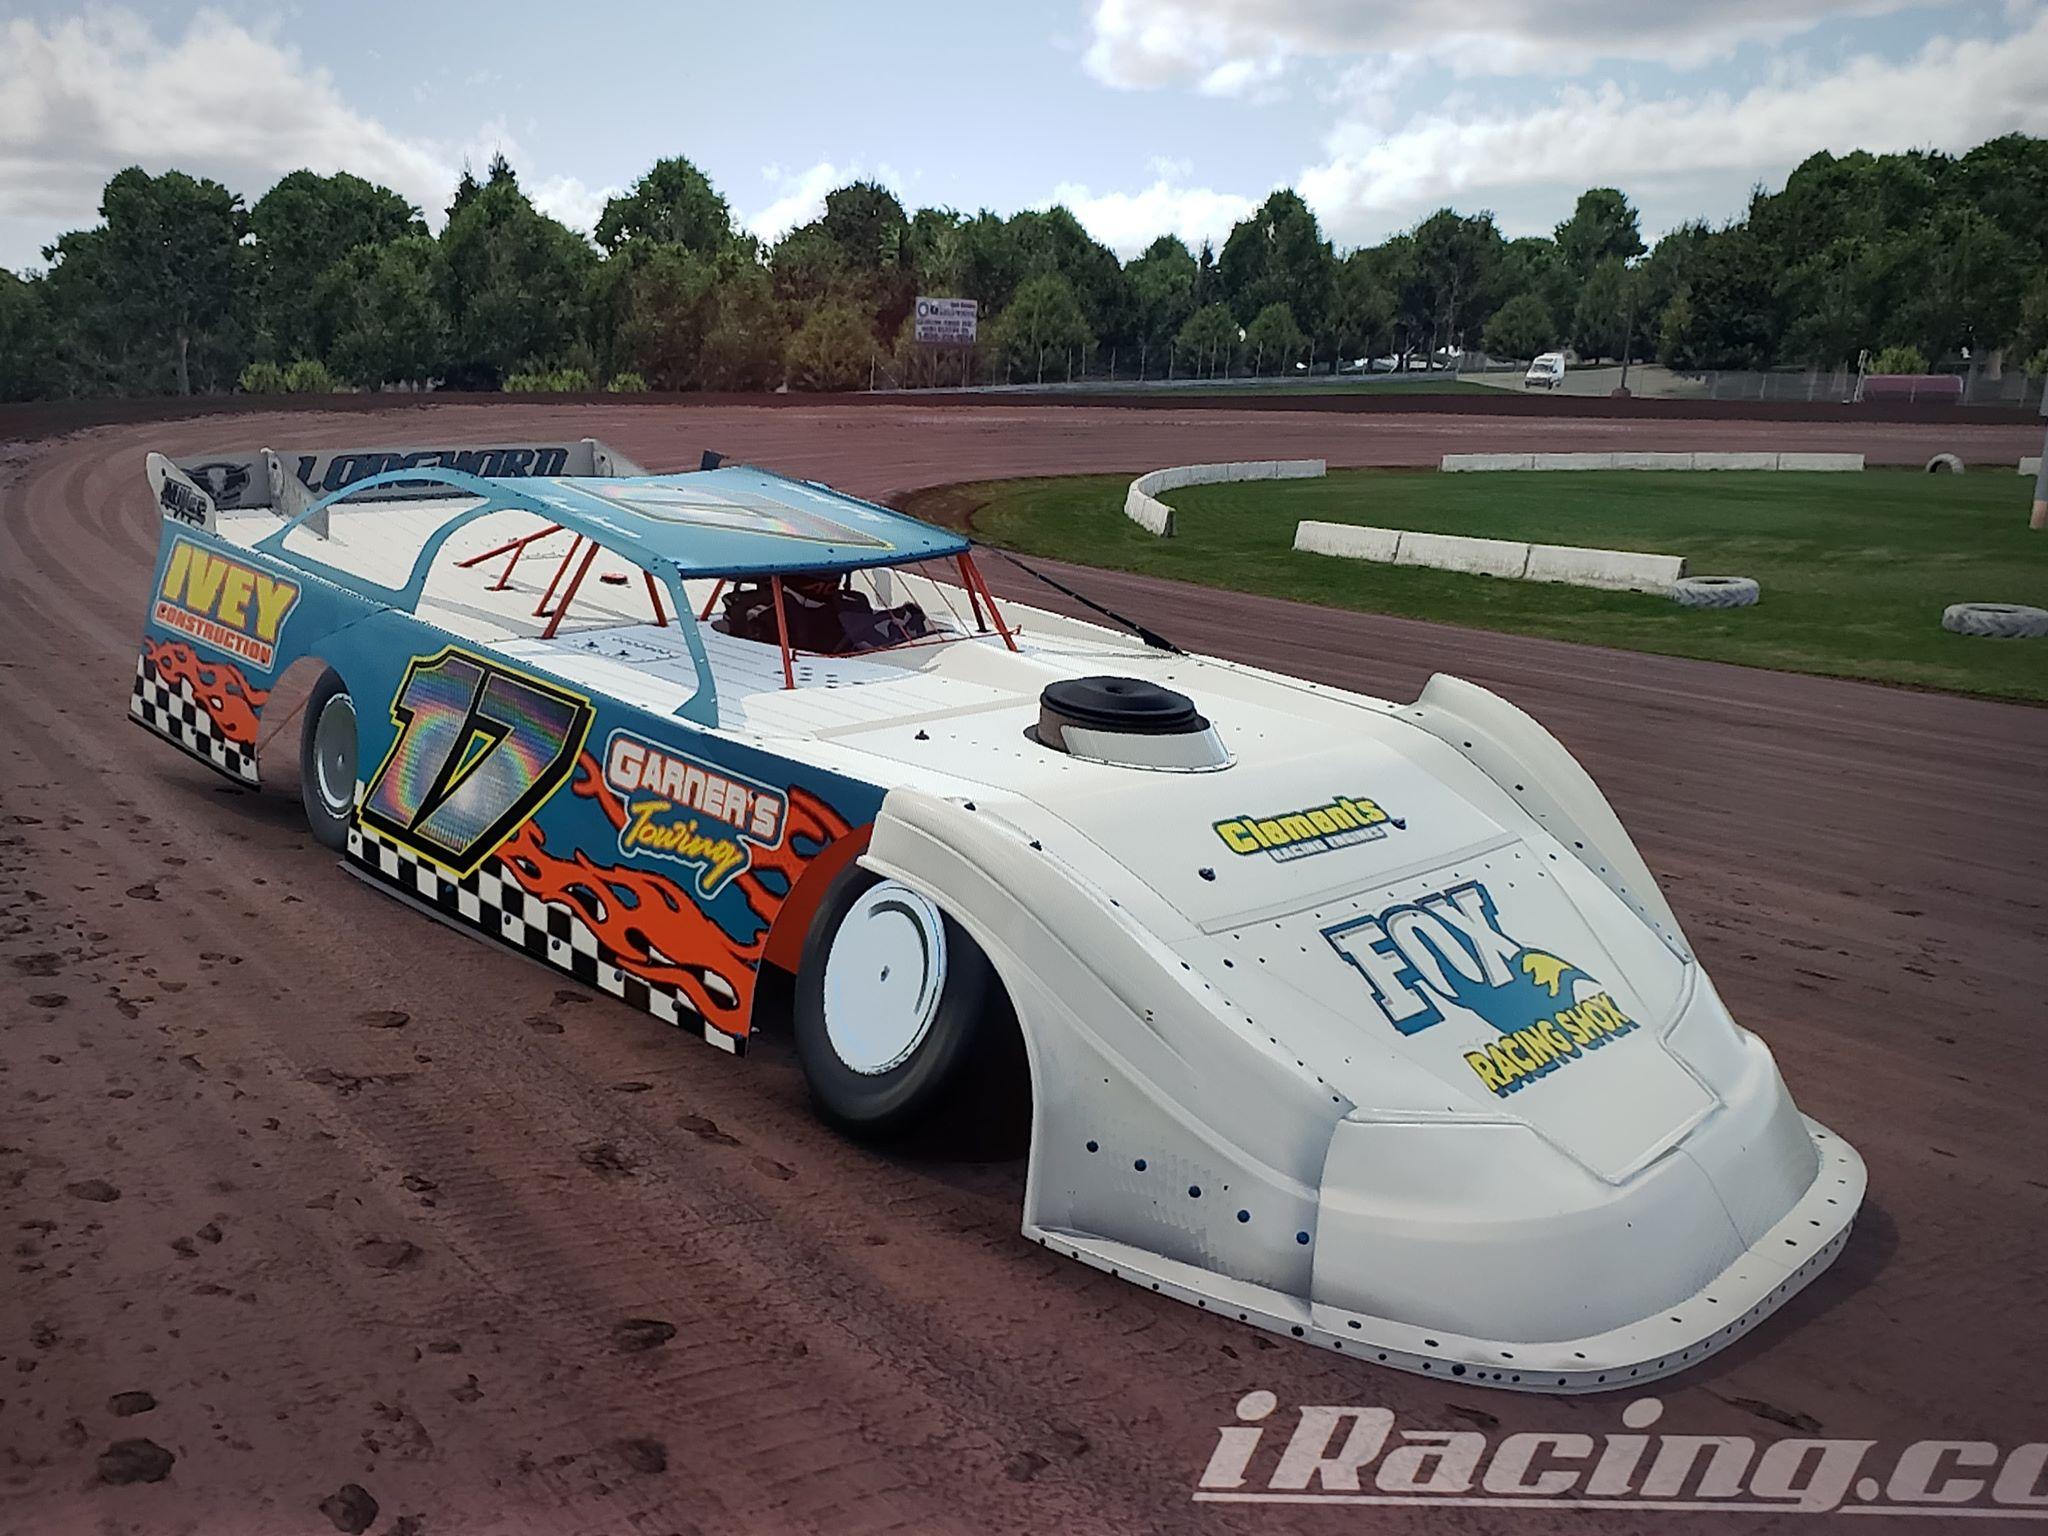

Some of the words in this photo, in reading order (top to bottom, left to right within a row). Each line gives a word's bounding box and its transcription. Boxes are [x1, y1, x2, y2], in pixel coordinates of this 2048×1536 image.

[155, 602, 272, 666] CONSTRUCTION
[163, 542, 298, 642] IVEY
[357, 645, 596, 879] 17
[608, 738, 780, 839] GARNER'S
[624, 800, 745, 889] Towing
[1320, 880, 1522, 1035] FOX
[1464, 1020, 1578, 1096] RACING
[1554, 992, 1637, 1049] SHOX
